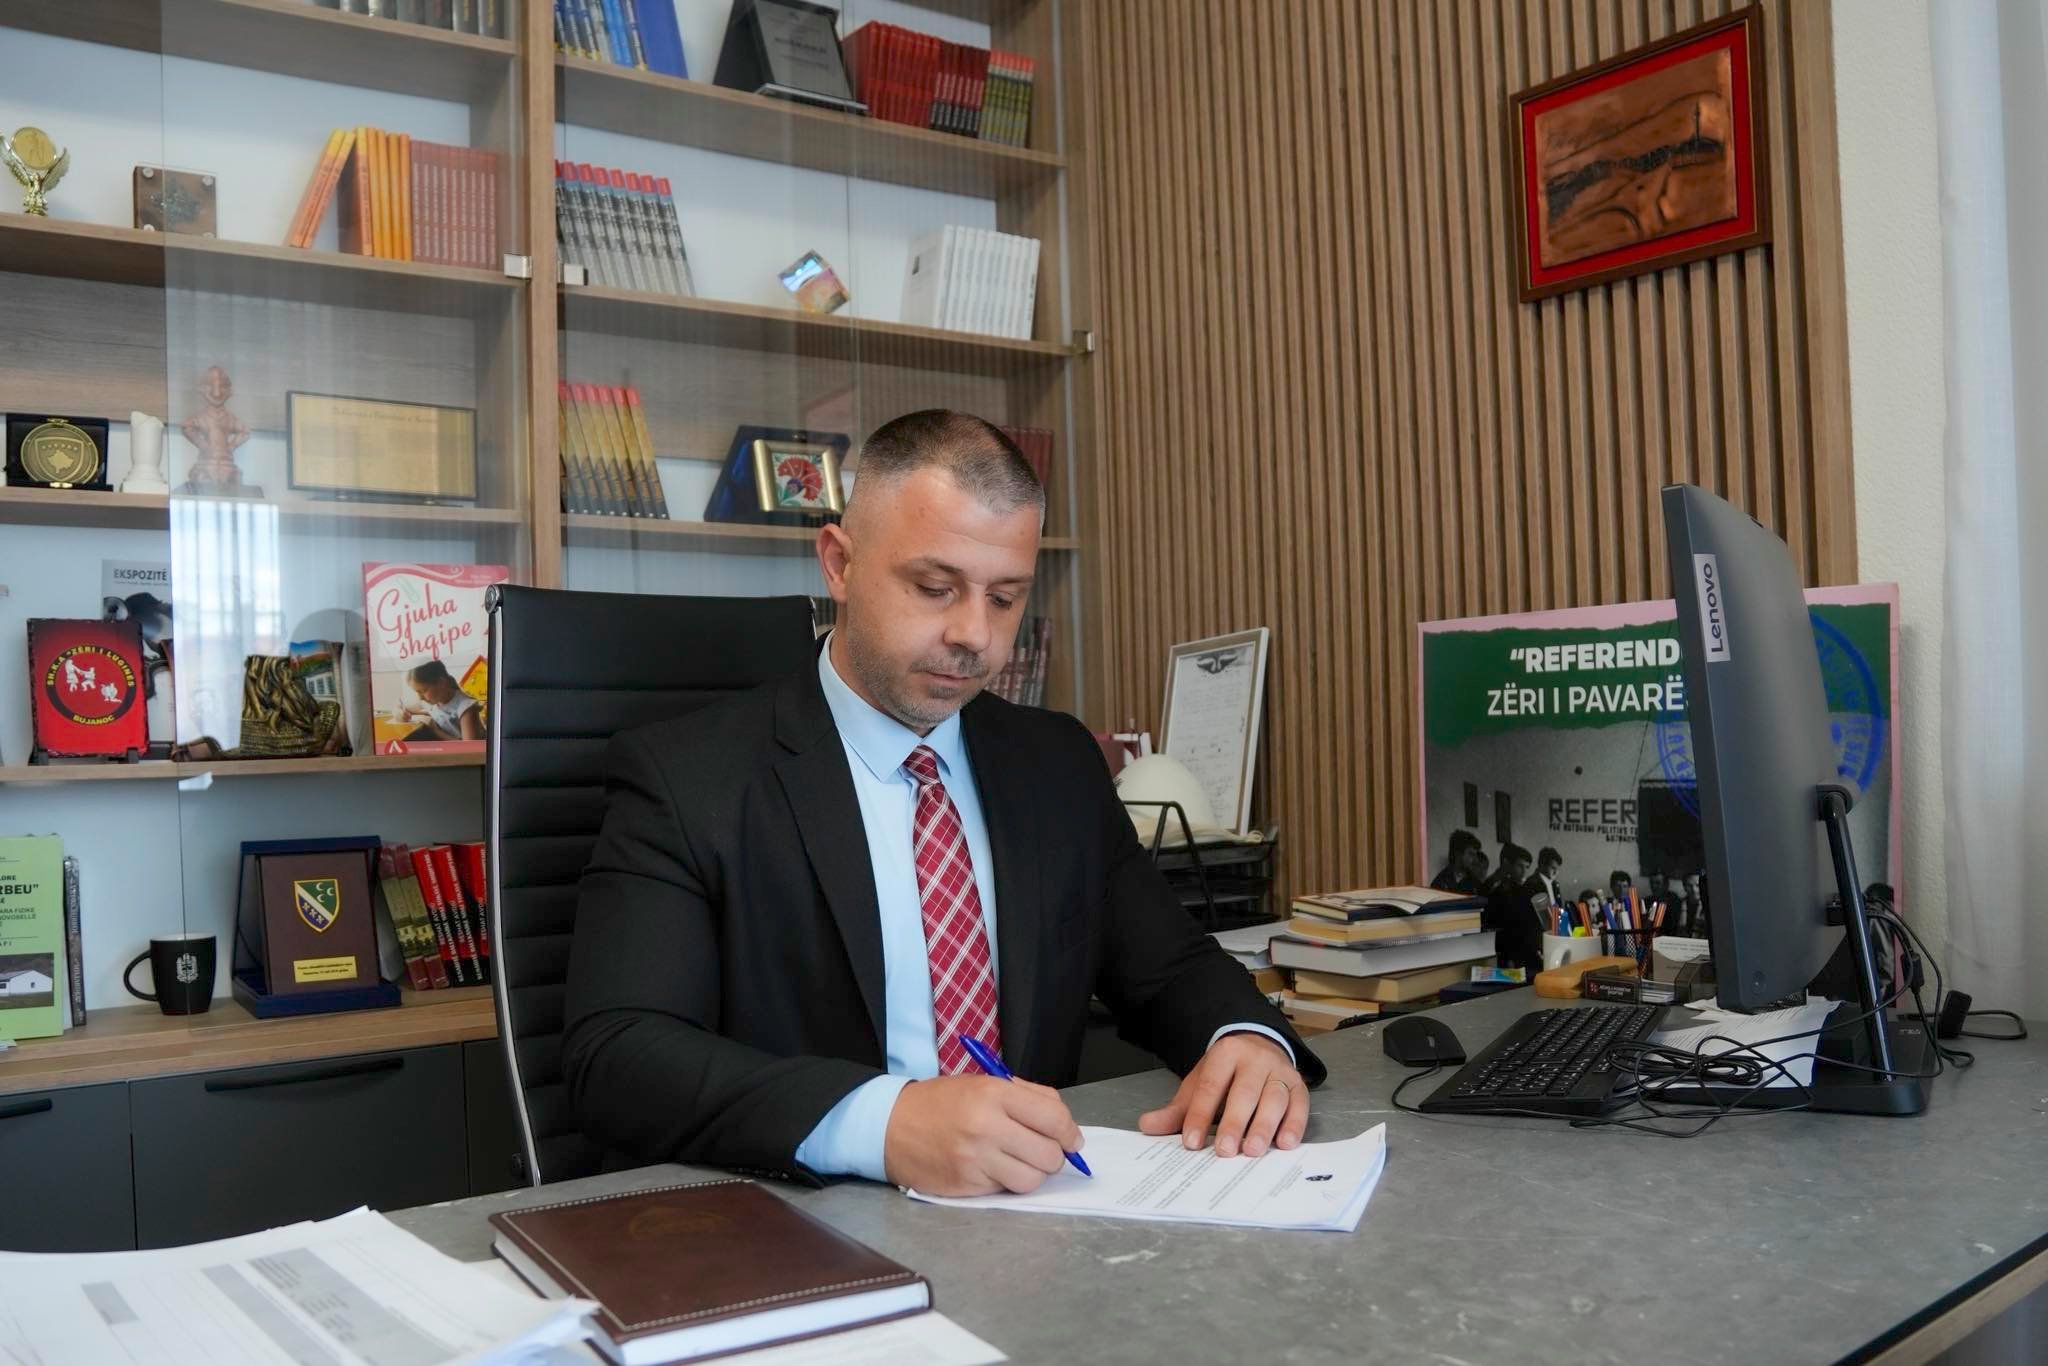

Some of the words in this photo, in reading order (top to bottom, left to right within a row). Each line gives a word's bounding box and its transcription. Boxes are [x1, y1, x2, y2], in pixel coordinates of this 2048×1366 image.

[377, 583, 458, 644] Gjuha
[1703, 562, 1724, 653] Lenovo
[400, 622, 472, 661] shqipe
[1510, 638, 1682, 672] “REFEREND
[1487, 682, 1544, 716] ZËRI
[1554, 687, 1560, 714] I
[1568, 674, 1688, 714] PAVARË
[73, 714, 114, 724] BUJANOC
[1548, 798, 1637, 824] REFER
